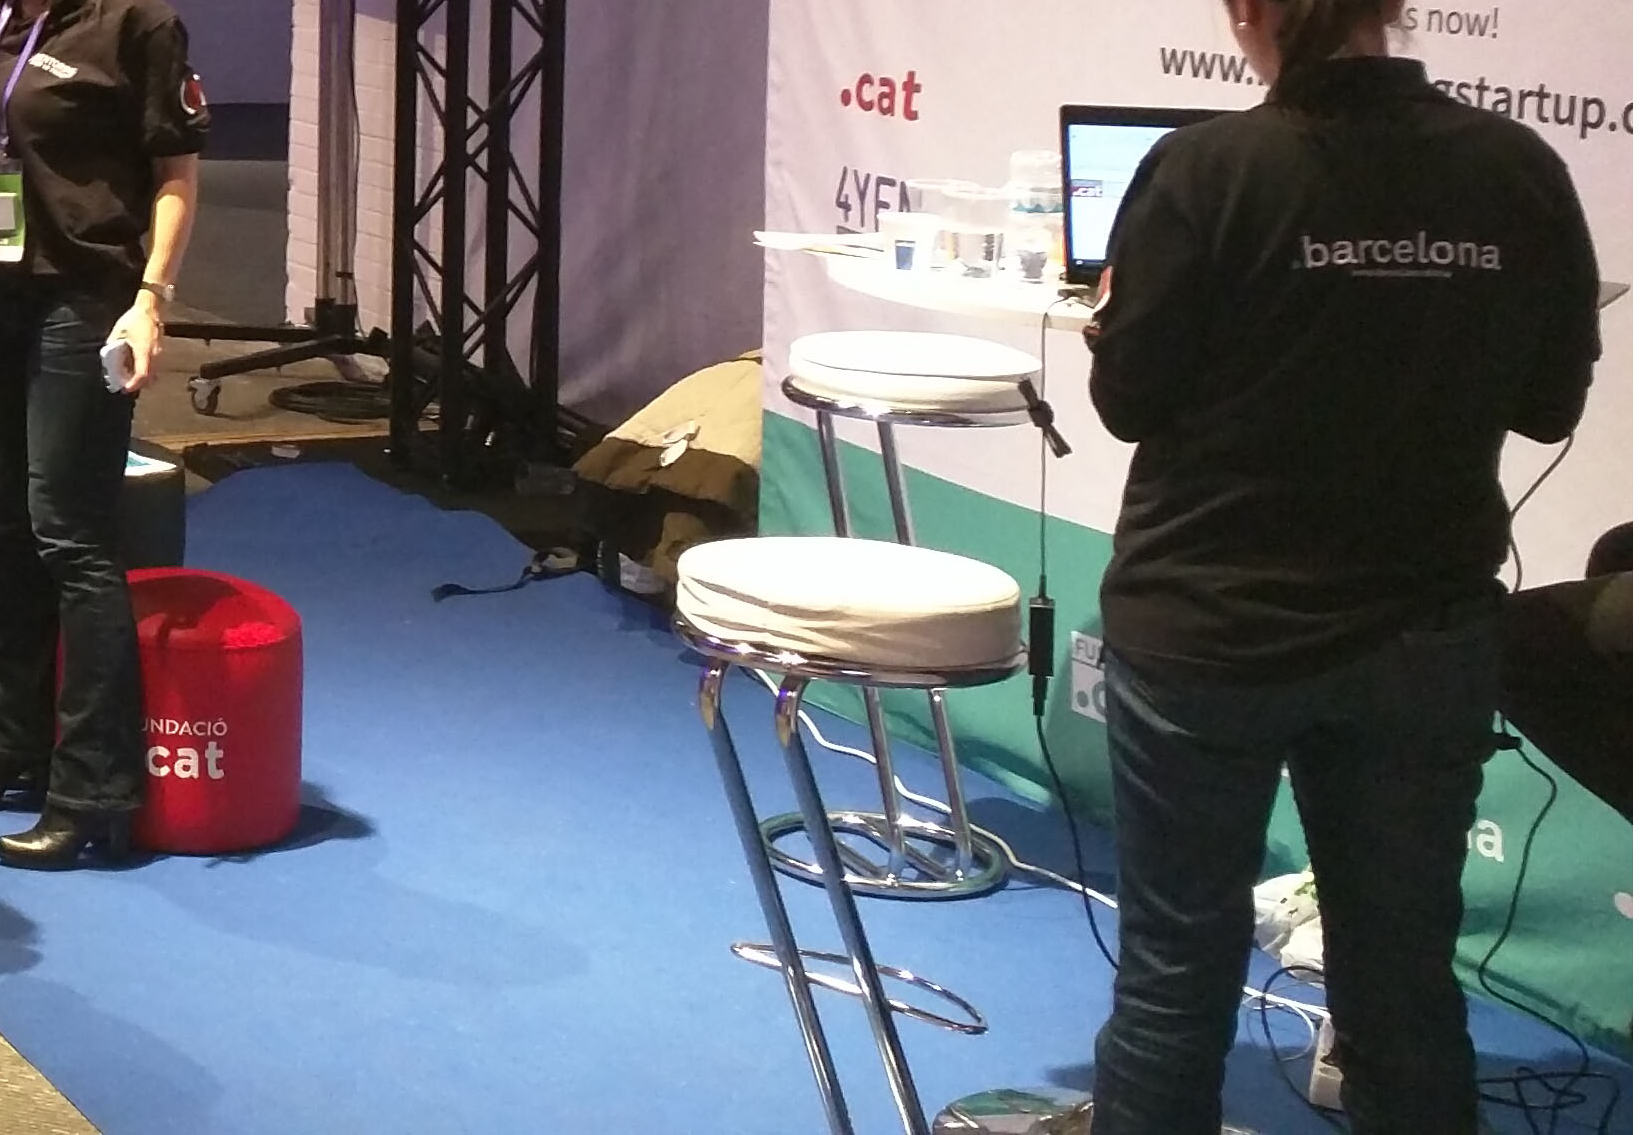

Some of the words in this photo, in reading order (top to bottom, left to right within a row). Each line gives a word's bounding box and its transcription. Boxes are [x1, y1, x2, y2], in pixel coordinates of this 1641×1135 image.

[1426, 7, 1500, 39] now!
[840, 70, 922, 122] .cat
[145, 741, 225, 780] cat
